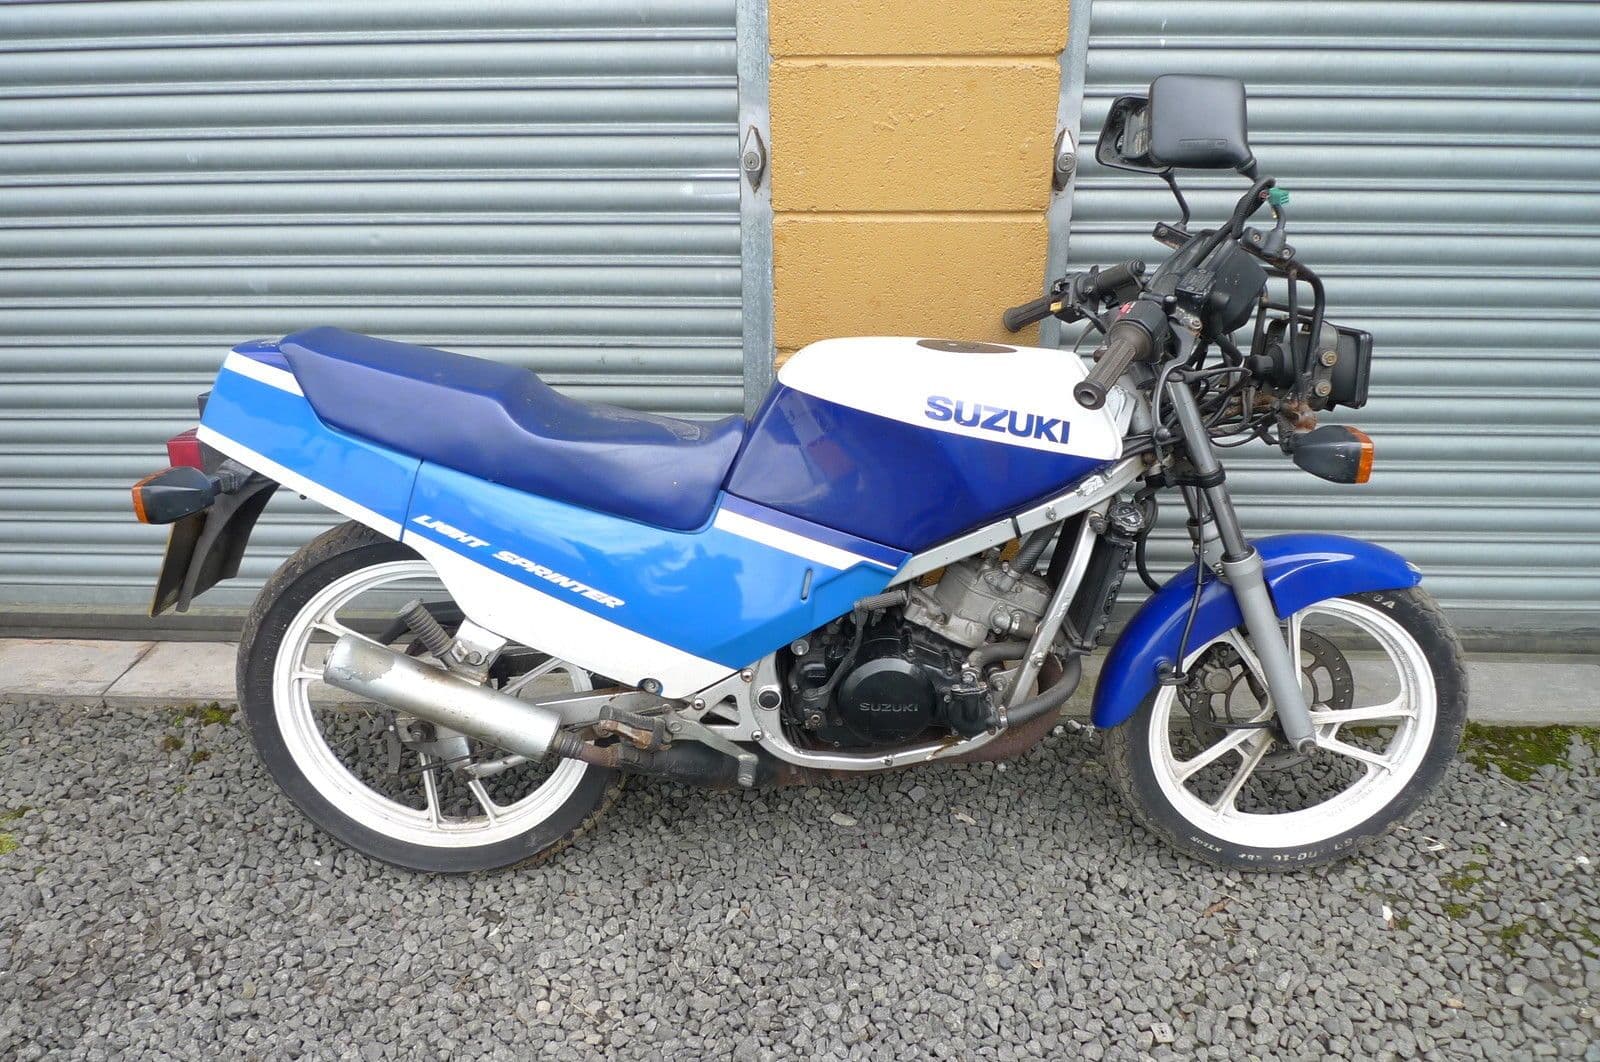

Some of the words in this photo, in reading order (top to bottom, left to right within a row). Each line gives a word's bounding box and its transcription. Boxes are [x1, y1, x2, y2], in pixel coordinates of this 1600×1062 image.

[925, 395, 1070, 444] SUZUKI
[412, 515, 491, 548] LIGHT
[492, 550, 626, 608] SPRINTER
[860, 702, 918, 712] SUZUKI
